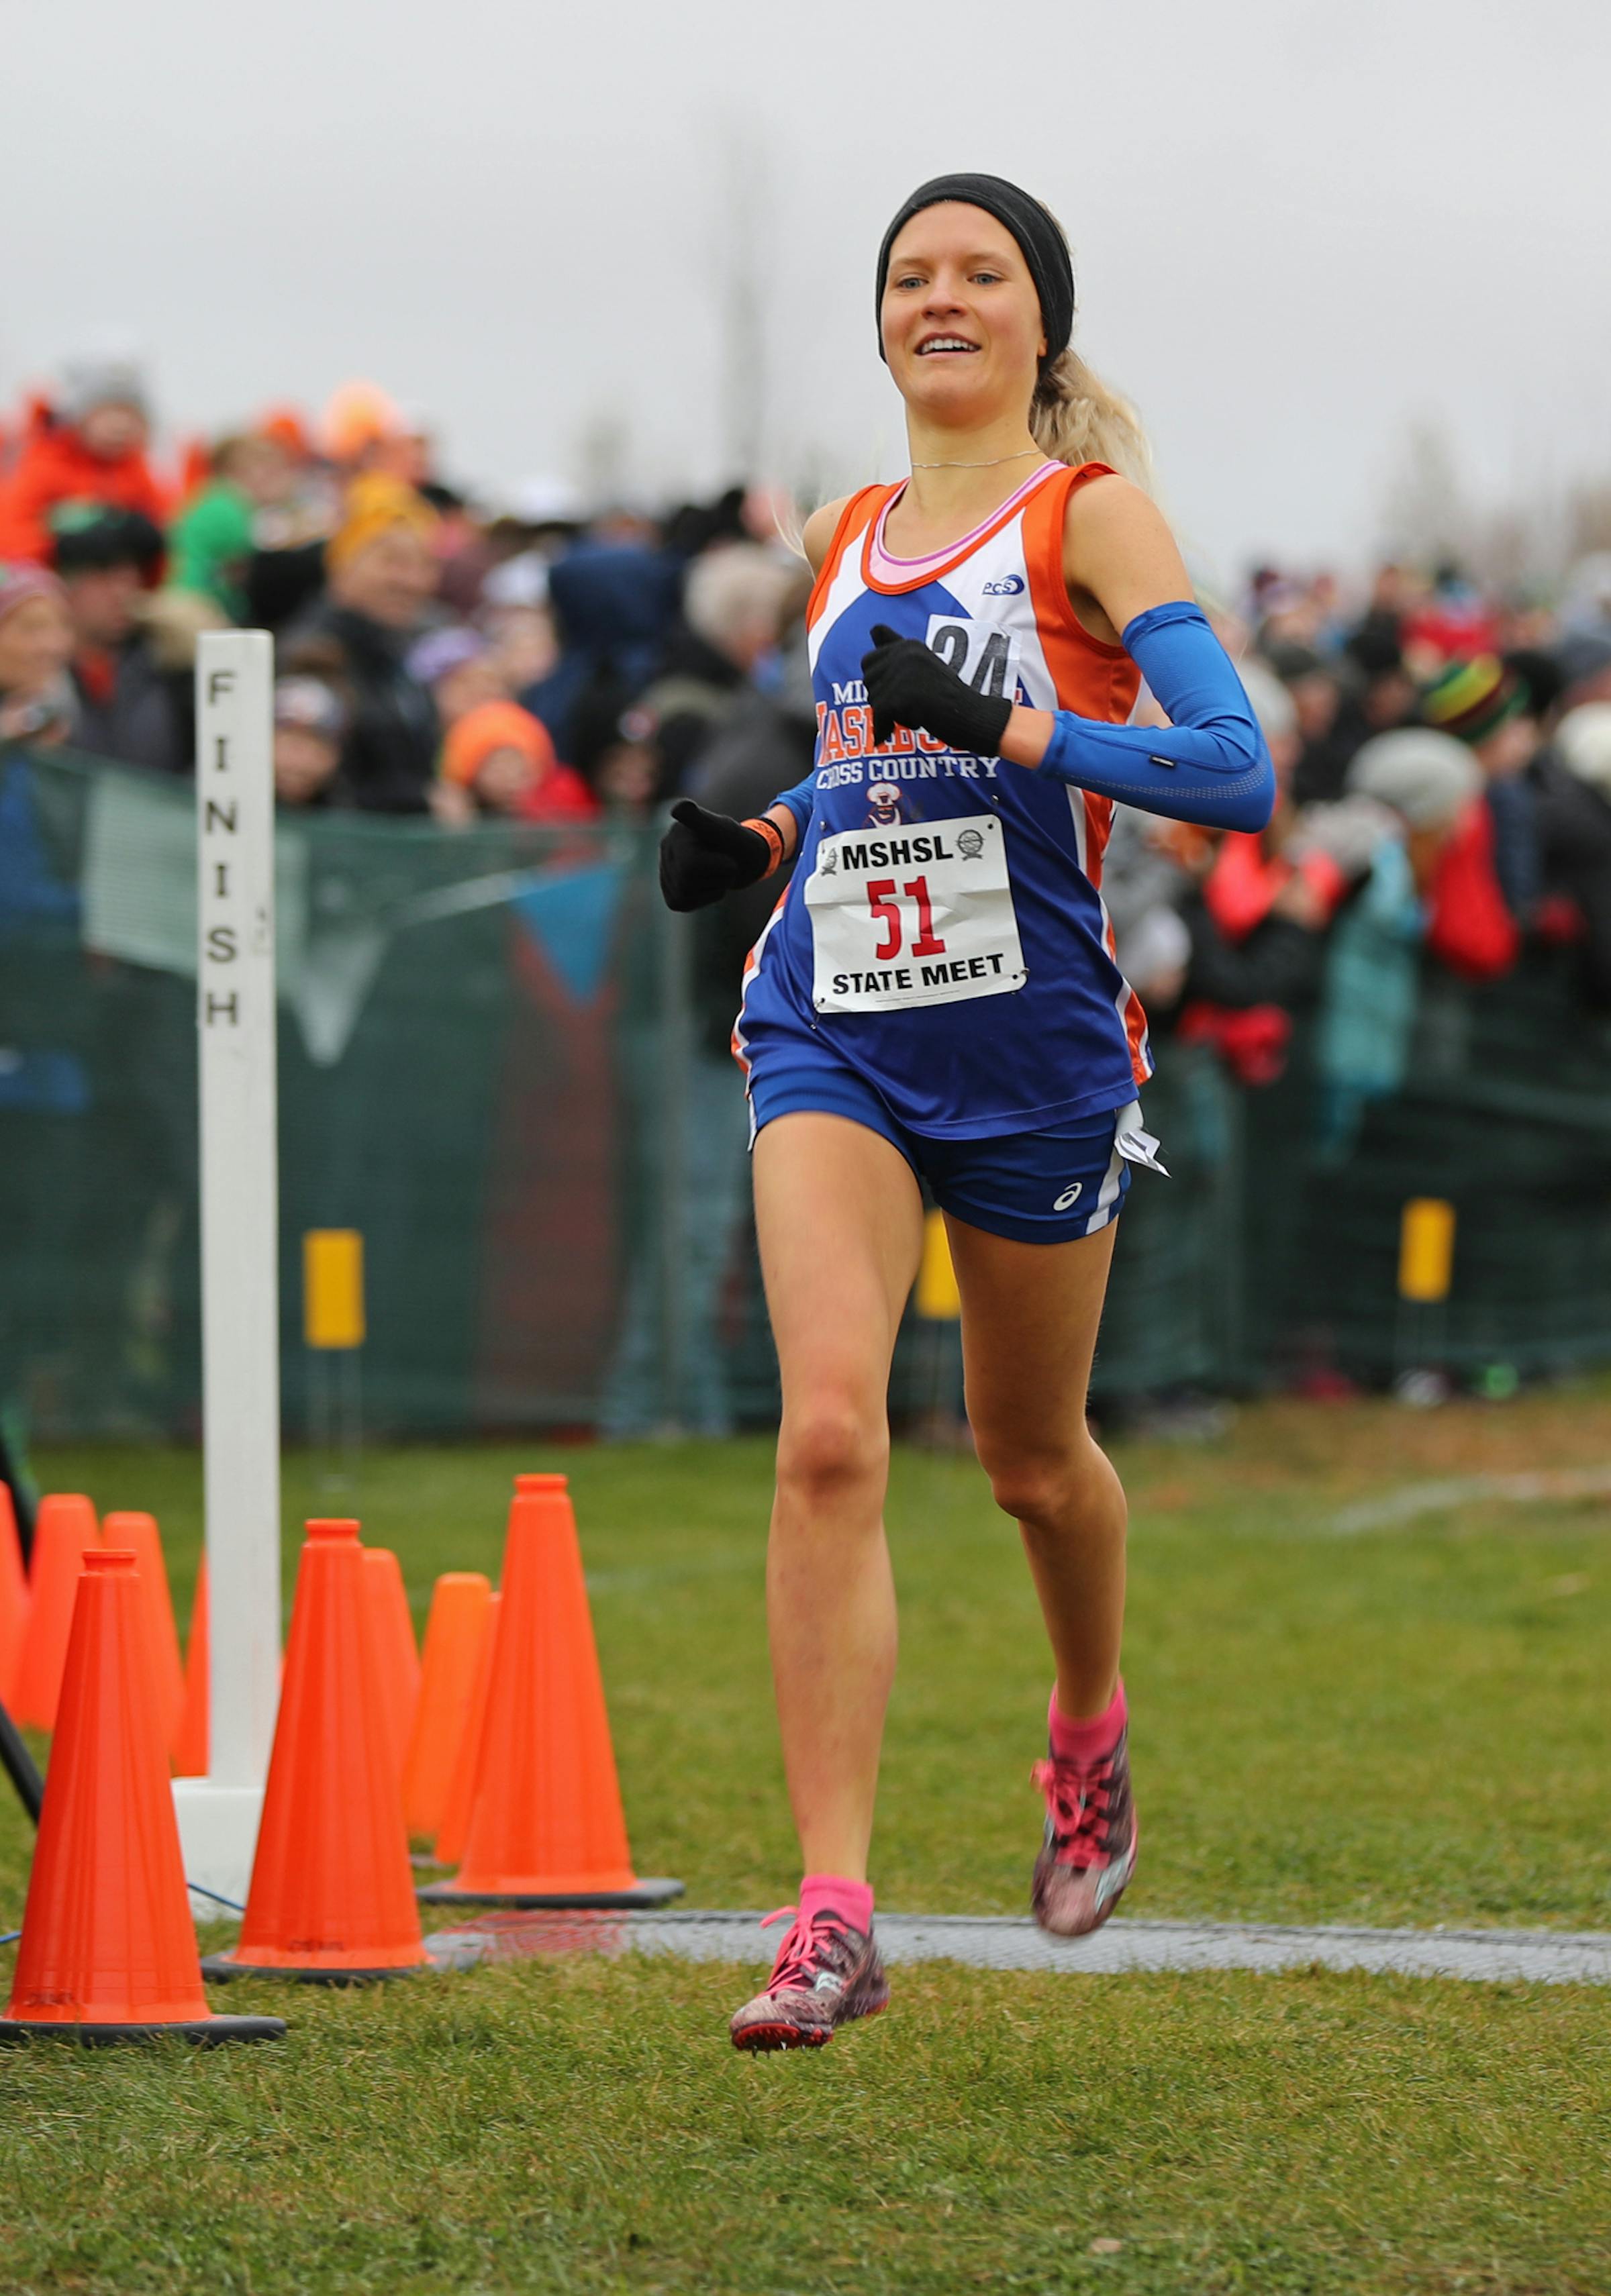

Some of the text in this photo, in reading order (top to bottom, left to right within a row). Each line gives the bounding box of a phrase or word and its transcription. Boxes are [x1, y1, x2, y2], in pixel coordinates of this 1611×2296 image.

[869, 756, 1000, 782] COUNTRY
[205, 672, 238, 1027] FINISH
[842, 836, 954, 870] MSHSL
[866, 875, 946, 960] 51
[832, 953, 1004, 995] STATE MEET
